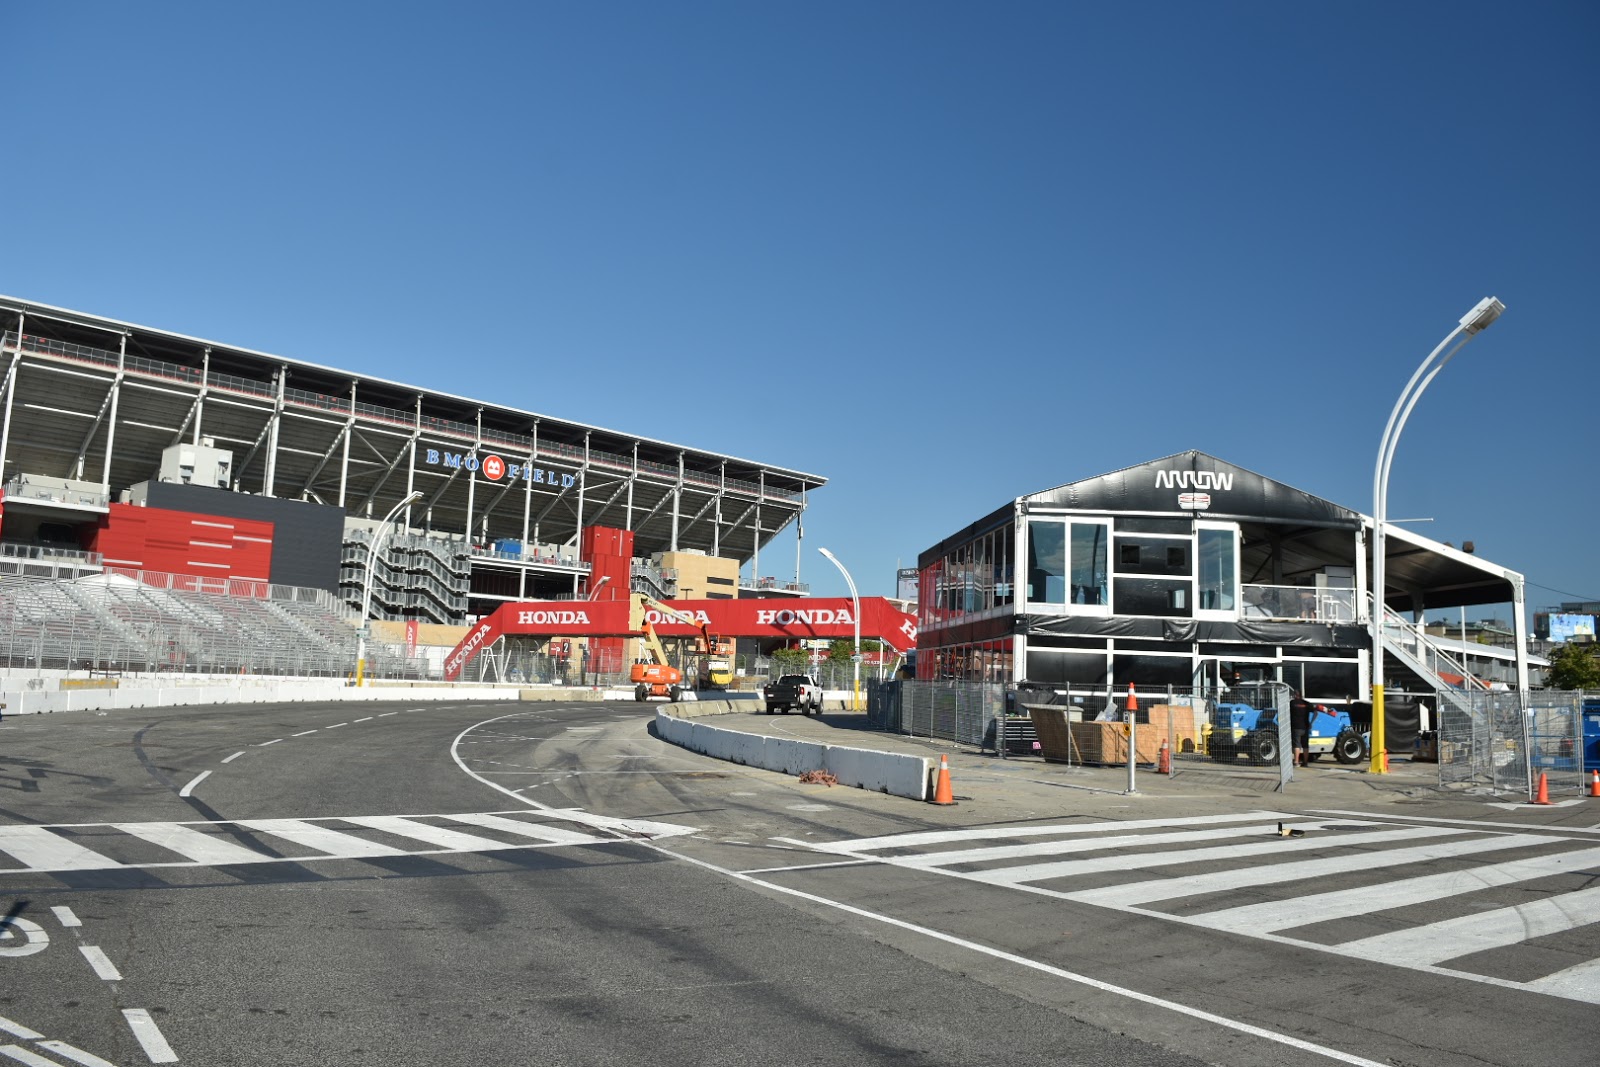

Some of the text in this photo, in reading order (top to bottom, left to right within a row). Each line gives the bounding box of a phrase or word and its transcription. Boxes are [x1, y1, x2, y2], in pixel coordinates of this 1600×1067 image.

[426, 449, 479, 472] BMO
[1155, 470, 1233, 491] ARROW
[518, 610, 590, 624] HONDA
[629, 610, 711, 624] ONDA
[756, 609, 855, 625] HONDA
[446, 623, 492, 675] HONDA
